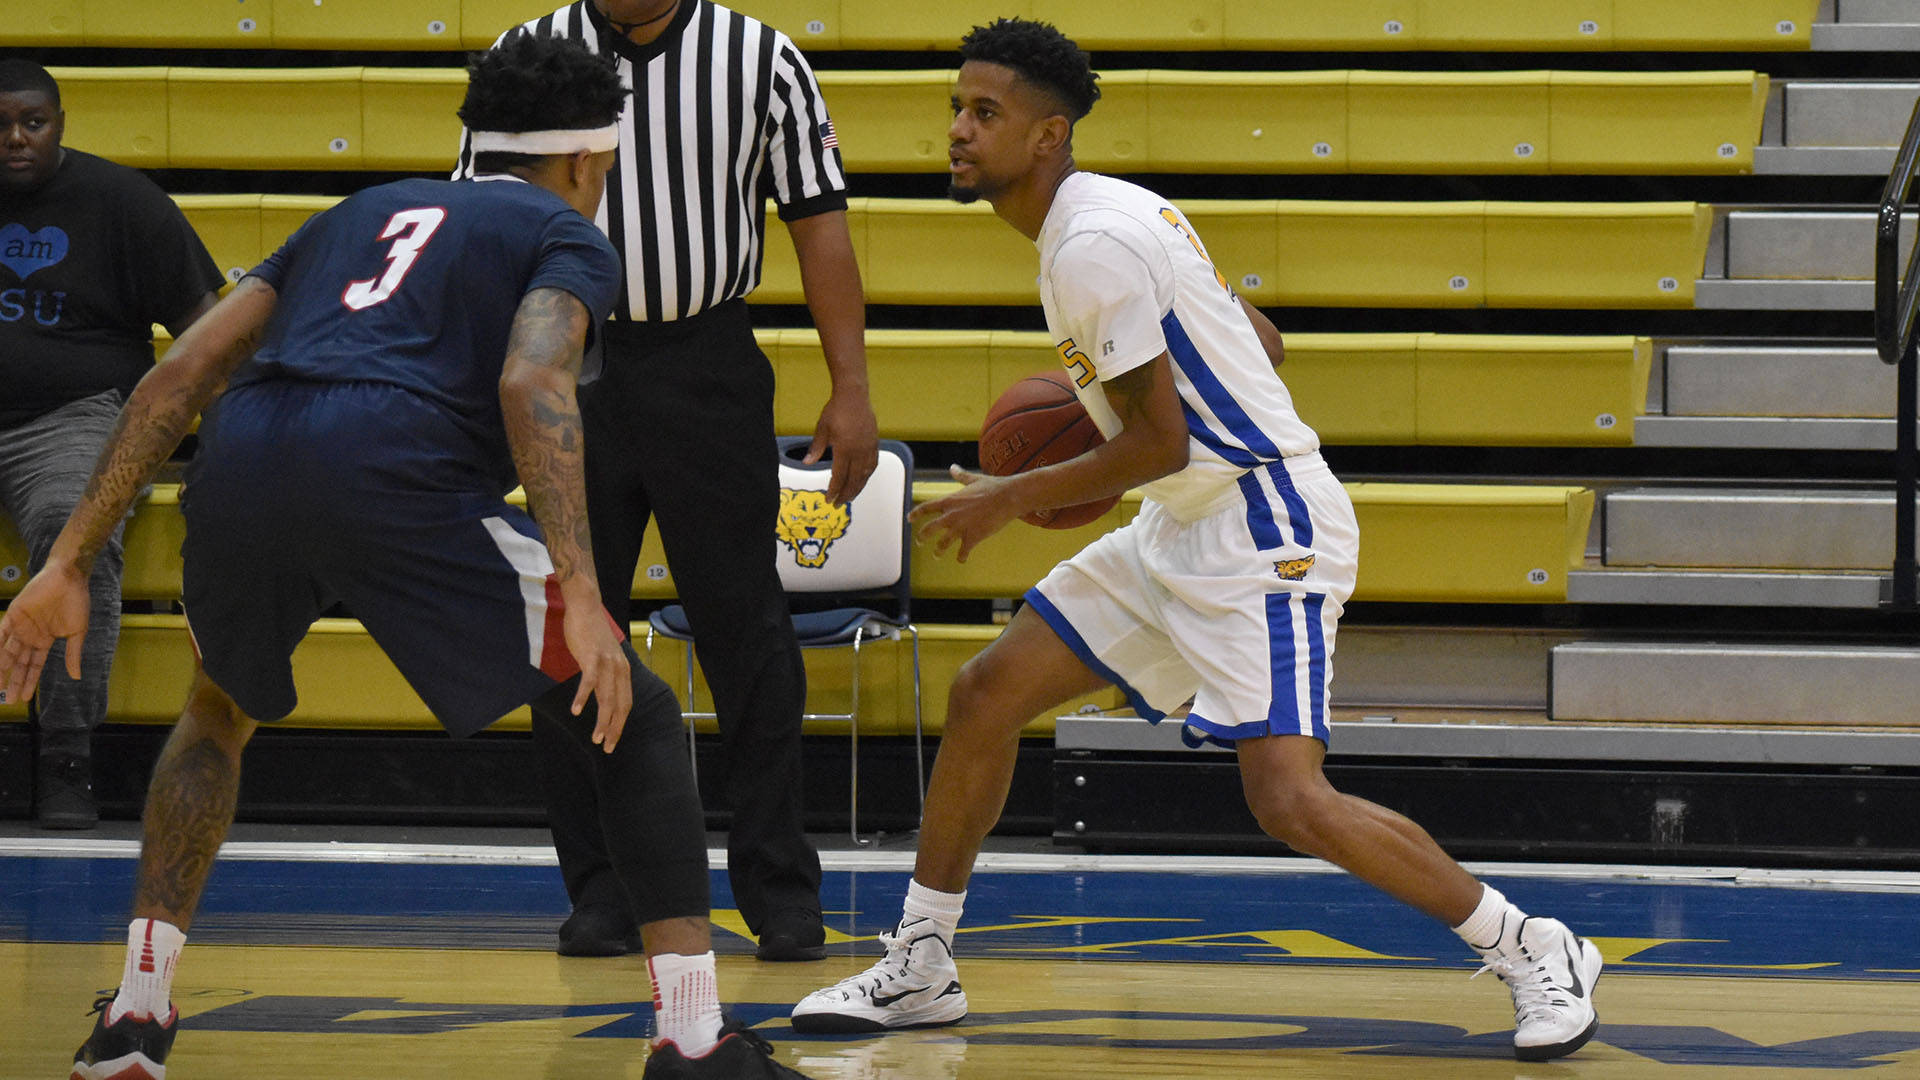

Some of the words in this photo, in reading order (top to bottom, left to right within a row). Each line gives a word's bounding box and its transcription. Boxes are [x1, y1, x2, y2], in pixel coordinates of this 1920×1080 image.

[5, 239, 54, 259] am
[341, 206, 448, 312] 3
[708, 908, 1920, 974] VAL
